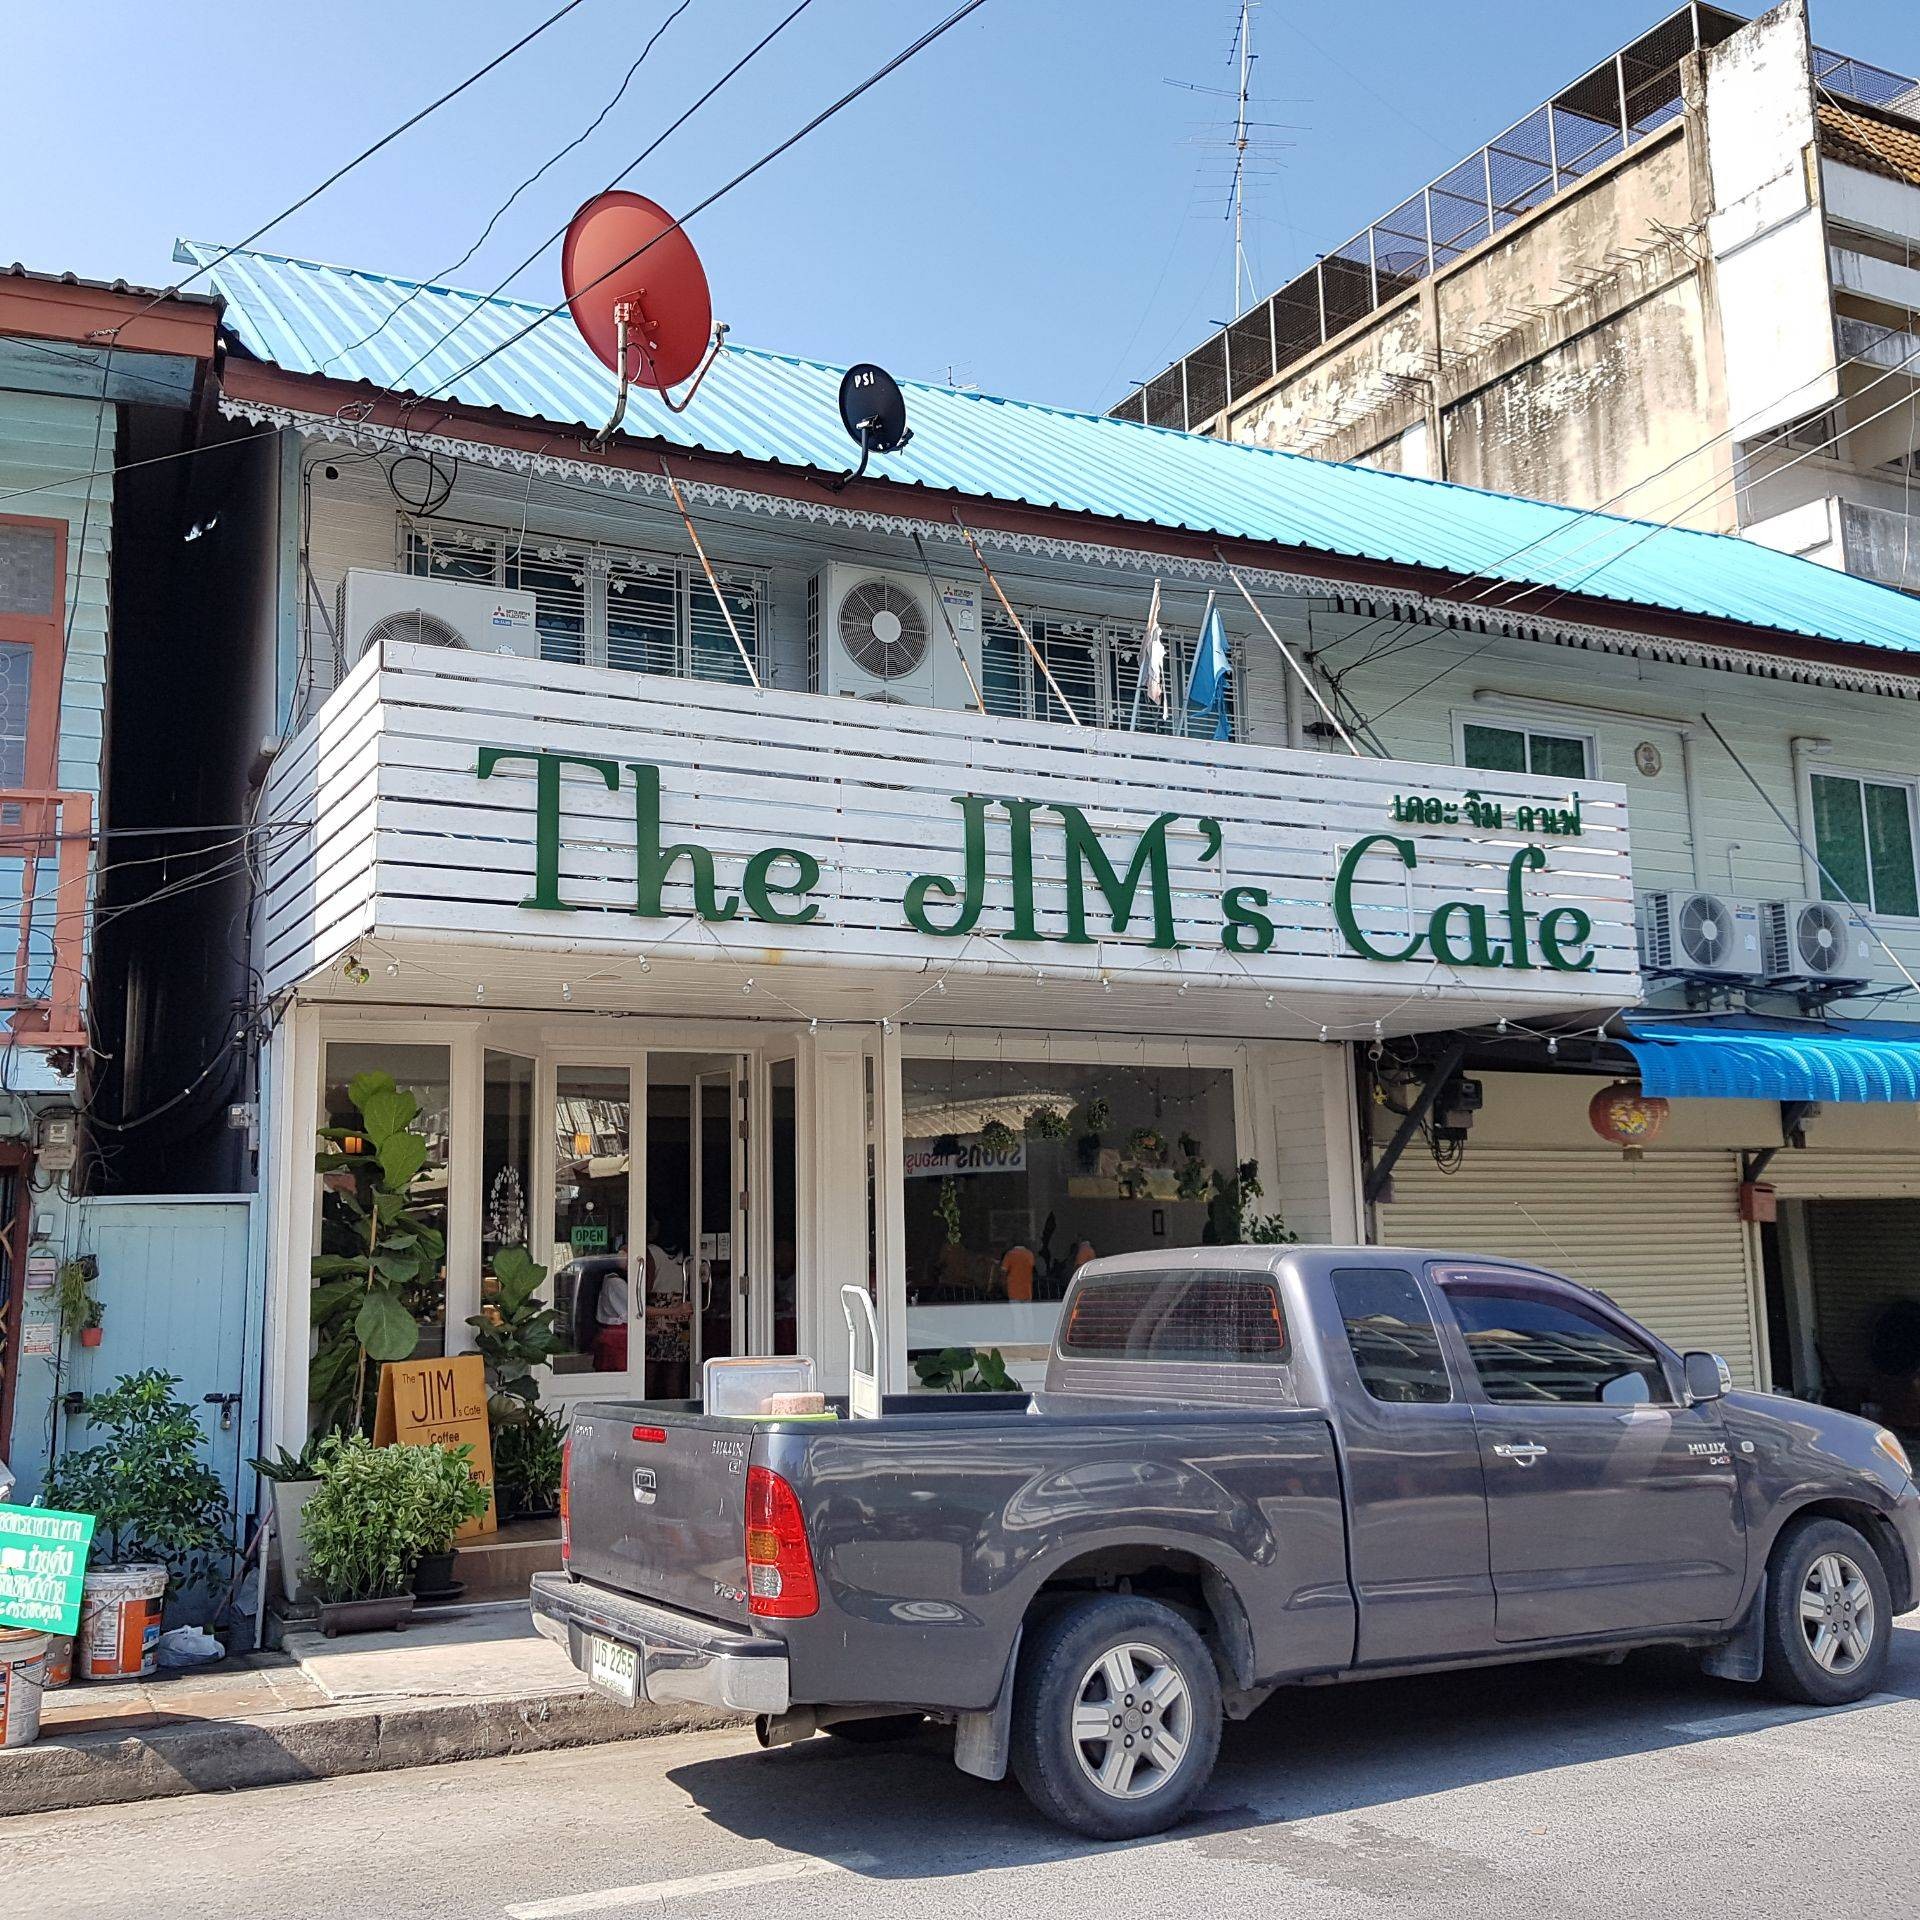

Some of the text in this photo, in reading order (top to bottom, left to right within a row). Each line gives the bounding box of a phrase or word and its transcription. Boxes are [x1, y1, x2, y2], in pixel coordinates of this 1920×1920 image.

[854, 371, 875, 388] PSI
[1394, 794, 1459, 824] เดอะ
[1463, 790, 1502, 829] จิม
[477, 746, 820, 924] The
[1334, 834, 1595, 971] Cafe
[575, 1229, 604, 1242] OPEN
[402, 1373, 416, 1385] The
[430, 1431, 460, 1445] Coffee
[1688, 1442, 1729, 1456] HILUX
[467, 1467, 486, 1482] kery
[610, 1646, 634, 1679] 2255
